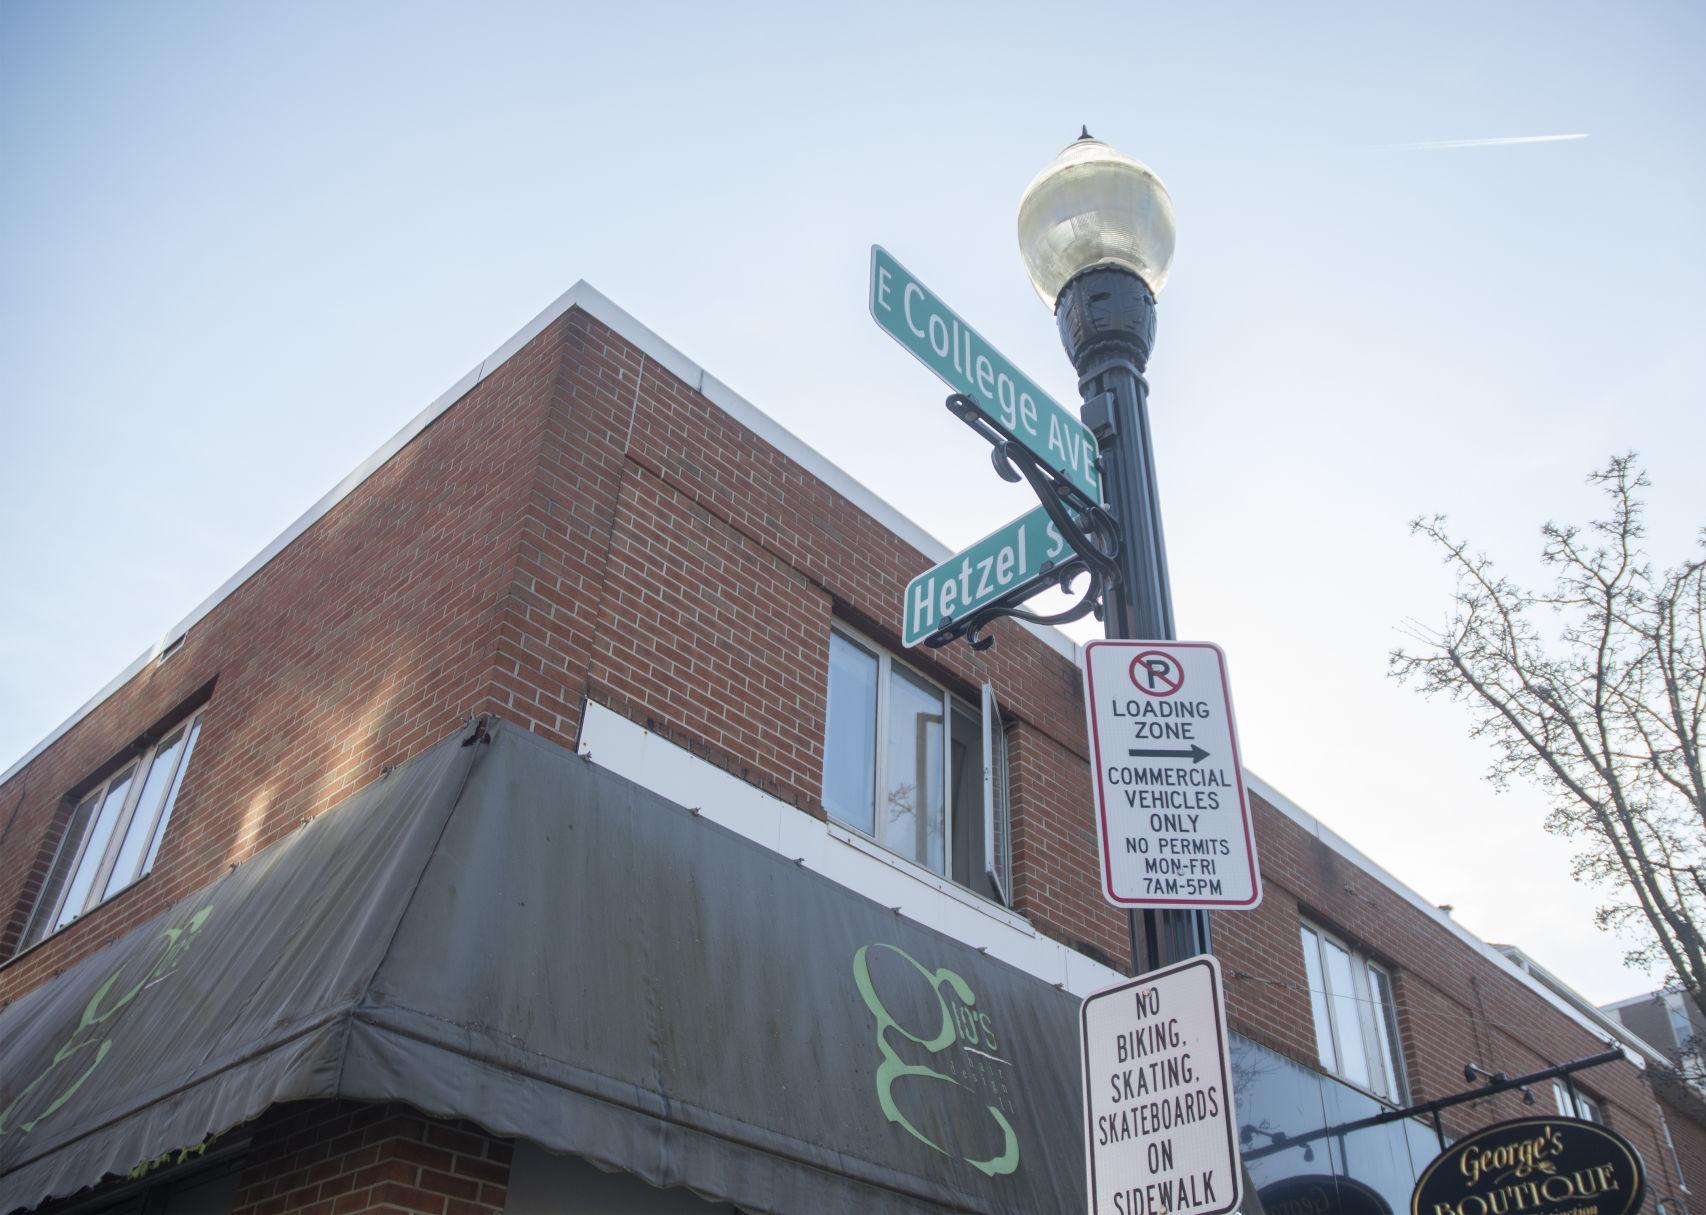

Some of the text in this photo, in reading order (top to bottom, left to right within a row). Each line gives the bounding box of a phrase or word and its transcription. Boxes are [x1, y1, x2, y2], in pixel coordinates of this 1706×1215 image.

[877, 265, 1097, 488] E College AVE
[913, 524, 1027, 634] Hetzel
[1112, 700, 1210, 719] LOADING
[1134, 722, 1195, 740] ZONE
[1108, 767, 1232, 788] COMMERCIAL
[1124, 790, 1220, 810] VEHICLES
[1150, 814, 1199, 833] ONLY
[1126, 838, 1230, 856] NO PERMITS
[1145, 858, 1216, 876] MON-FRI
[1143, 878, 1222, 896] 7AM-5PM
[1136, 987, 1160, 1020] NO
[1116, 1018, 1186, 1063] BIKING,
[1110, 1053, 1200, 1103] SKATING,
[1098, 1086, 1219, 1146] SKATEBOARDS
[1148, 1139, 1174, 1174] ON
[1460, 1126, 1564, 1187] George's
[1113, 1170, 1217, 1215] SIDEWALK
